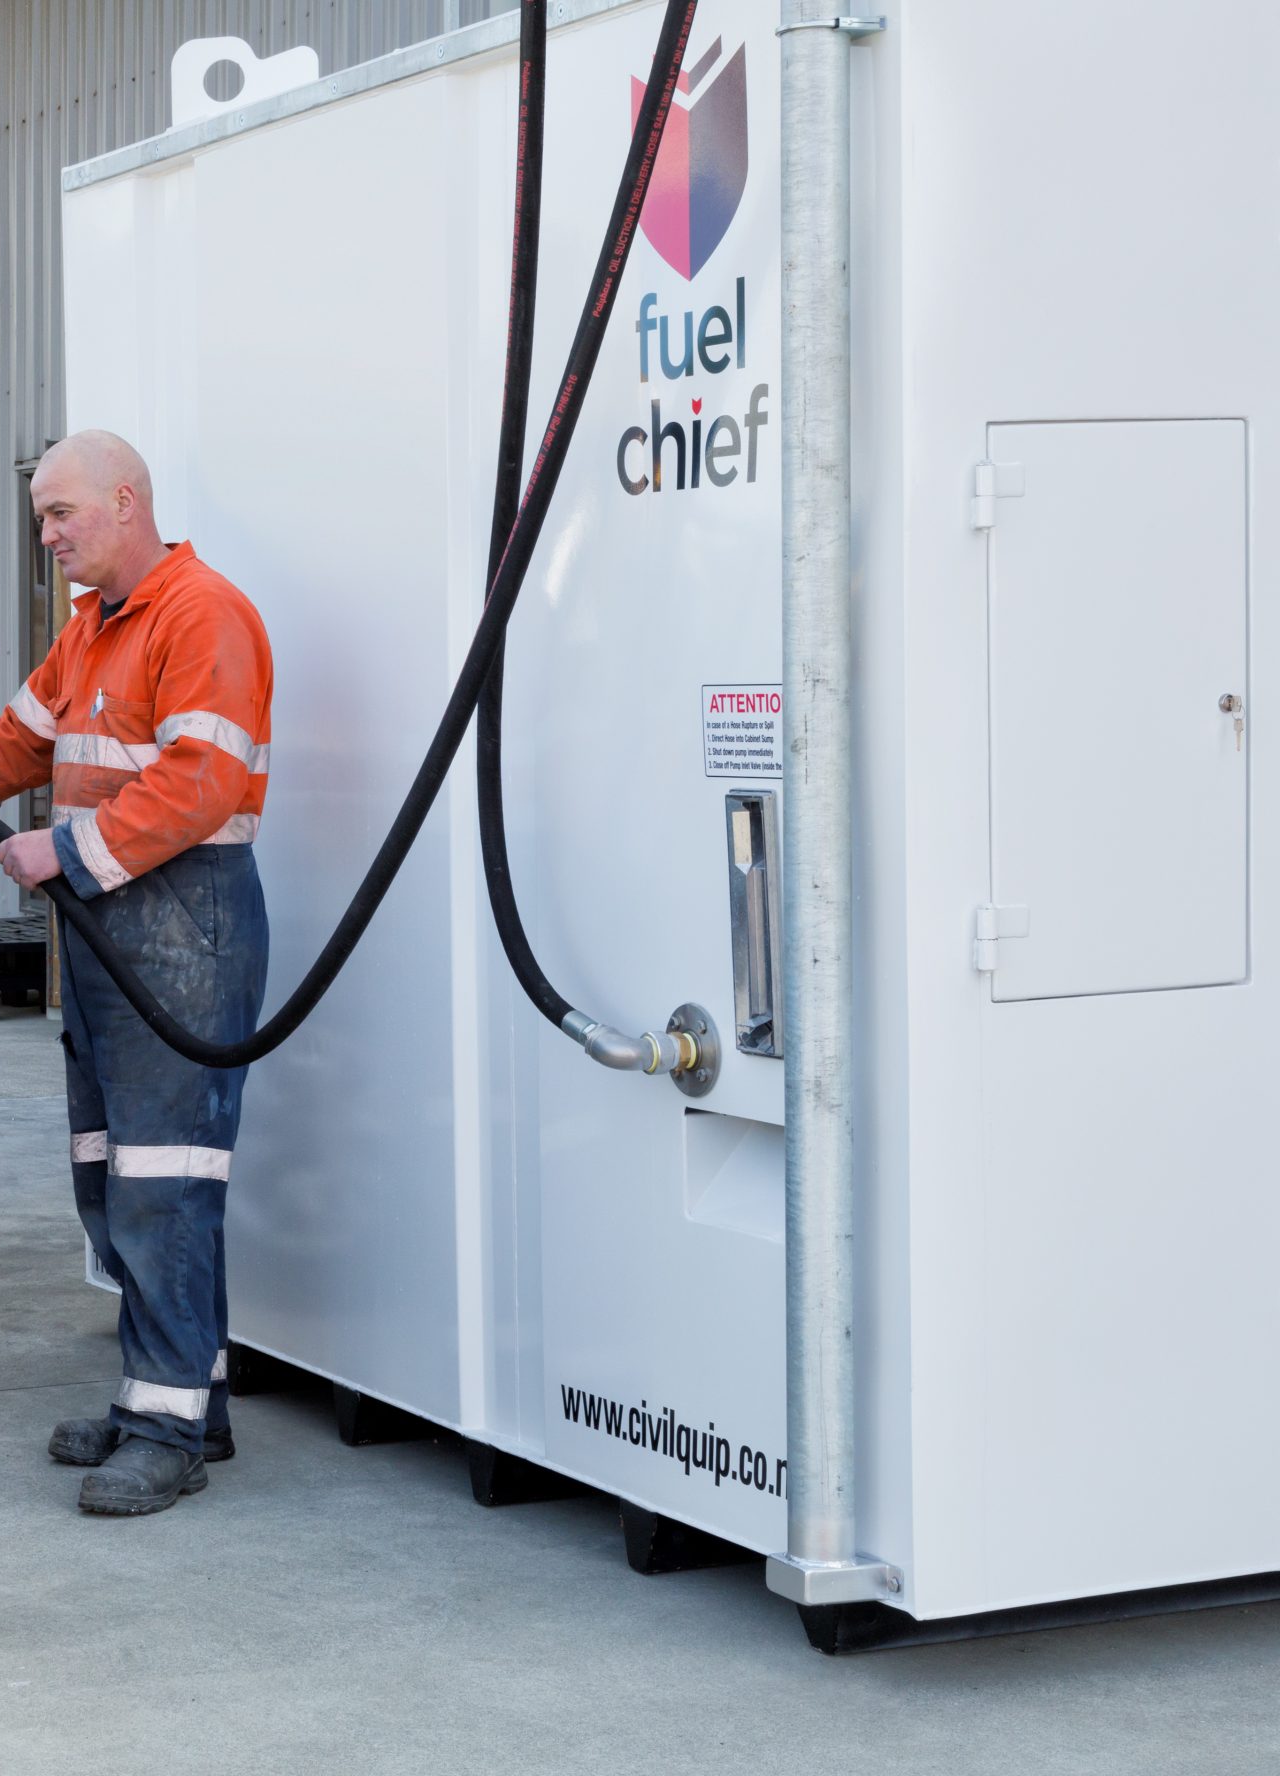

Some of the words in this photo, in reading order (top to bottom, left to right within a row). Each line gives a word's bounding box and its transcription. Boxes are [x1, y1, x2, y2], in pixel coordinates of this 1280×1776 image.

[654, 109, 666, 129] SAE
[646, 130, 660, 157] HOSE
[631, 159, 651, 205] DELIVERY
[614, 215, 635, 256] SUCTION
[609, 257, 621, 272] OIL
[635, 276, 746, 383] fuel
[550, 415, 561, 431] PSI
[617, 383, 769, 496] chief
[710, 693, 782, 713] ATTENTIO
[722, 721, 726, 729] of
[731, 721, 741, 729] Hose
[742, 721, 758, 730] Rupture
[764, 721, 774, 730] Spill
[712, 734, 724, 742] Direct
[725, 734, 735, 742] Hose
[745, 734, 761, 743] Cabinet
[761, 735, 774, 744] Sump
[713, 748, 722, 756] Shut
[723, 748, 734, 756] down
[735, 749, 747, 758] pump
[748, 748, 774, 758] immediately
[713, 761, 724, 769] Close
[730, 761, 741, 771] Pump
[742, 761, 750, 770] Inlet
[751, 762, 761, 770] Valve
[775, 762, 783, 770] the
[561, 1384, 788, 1500] www.civilquip.co.n
